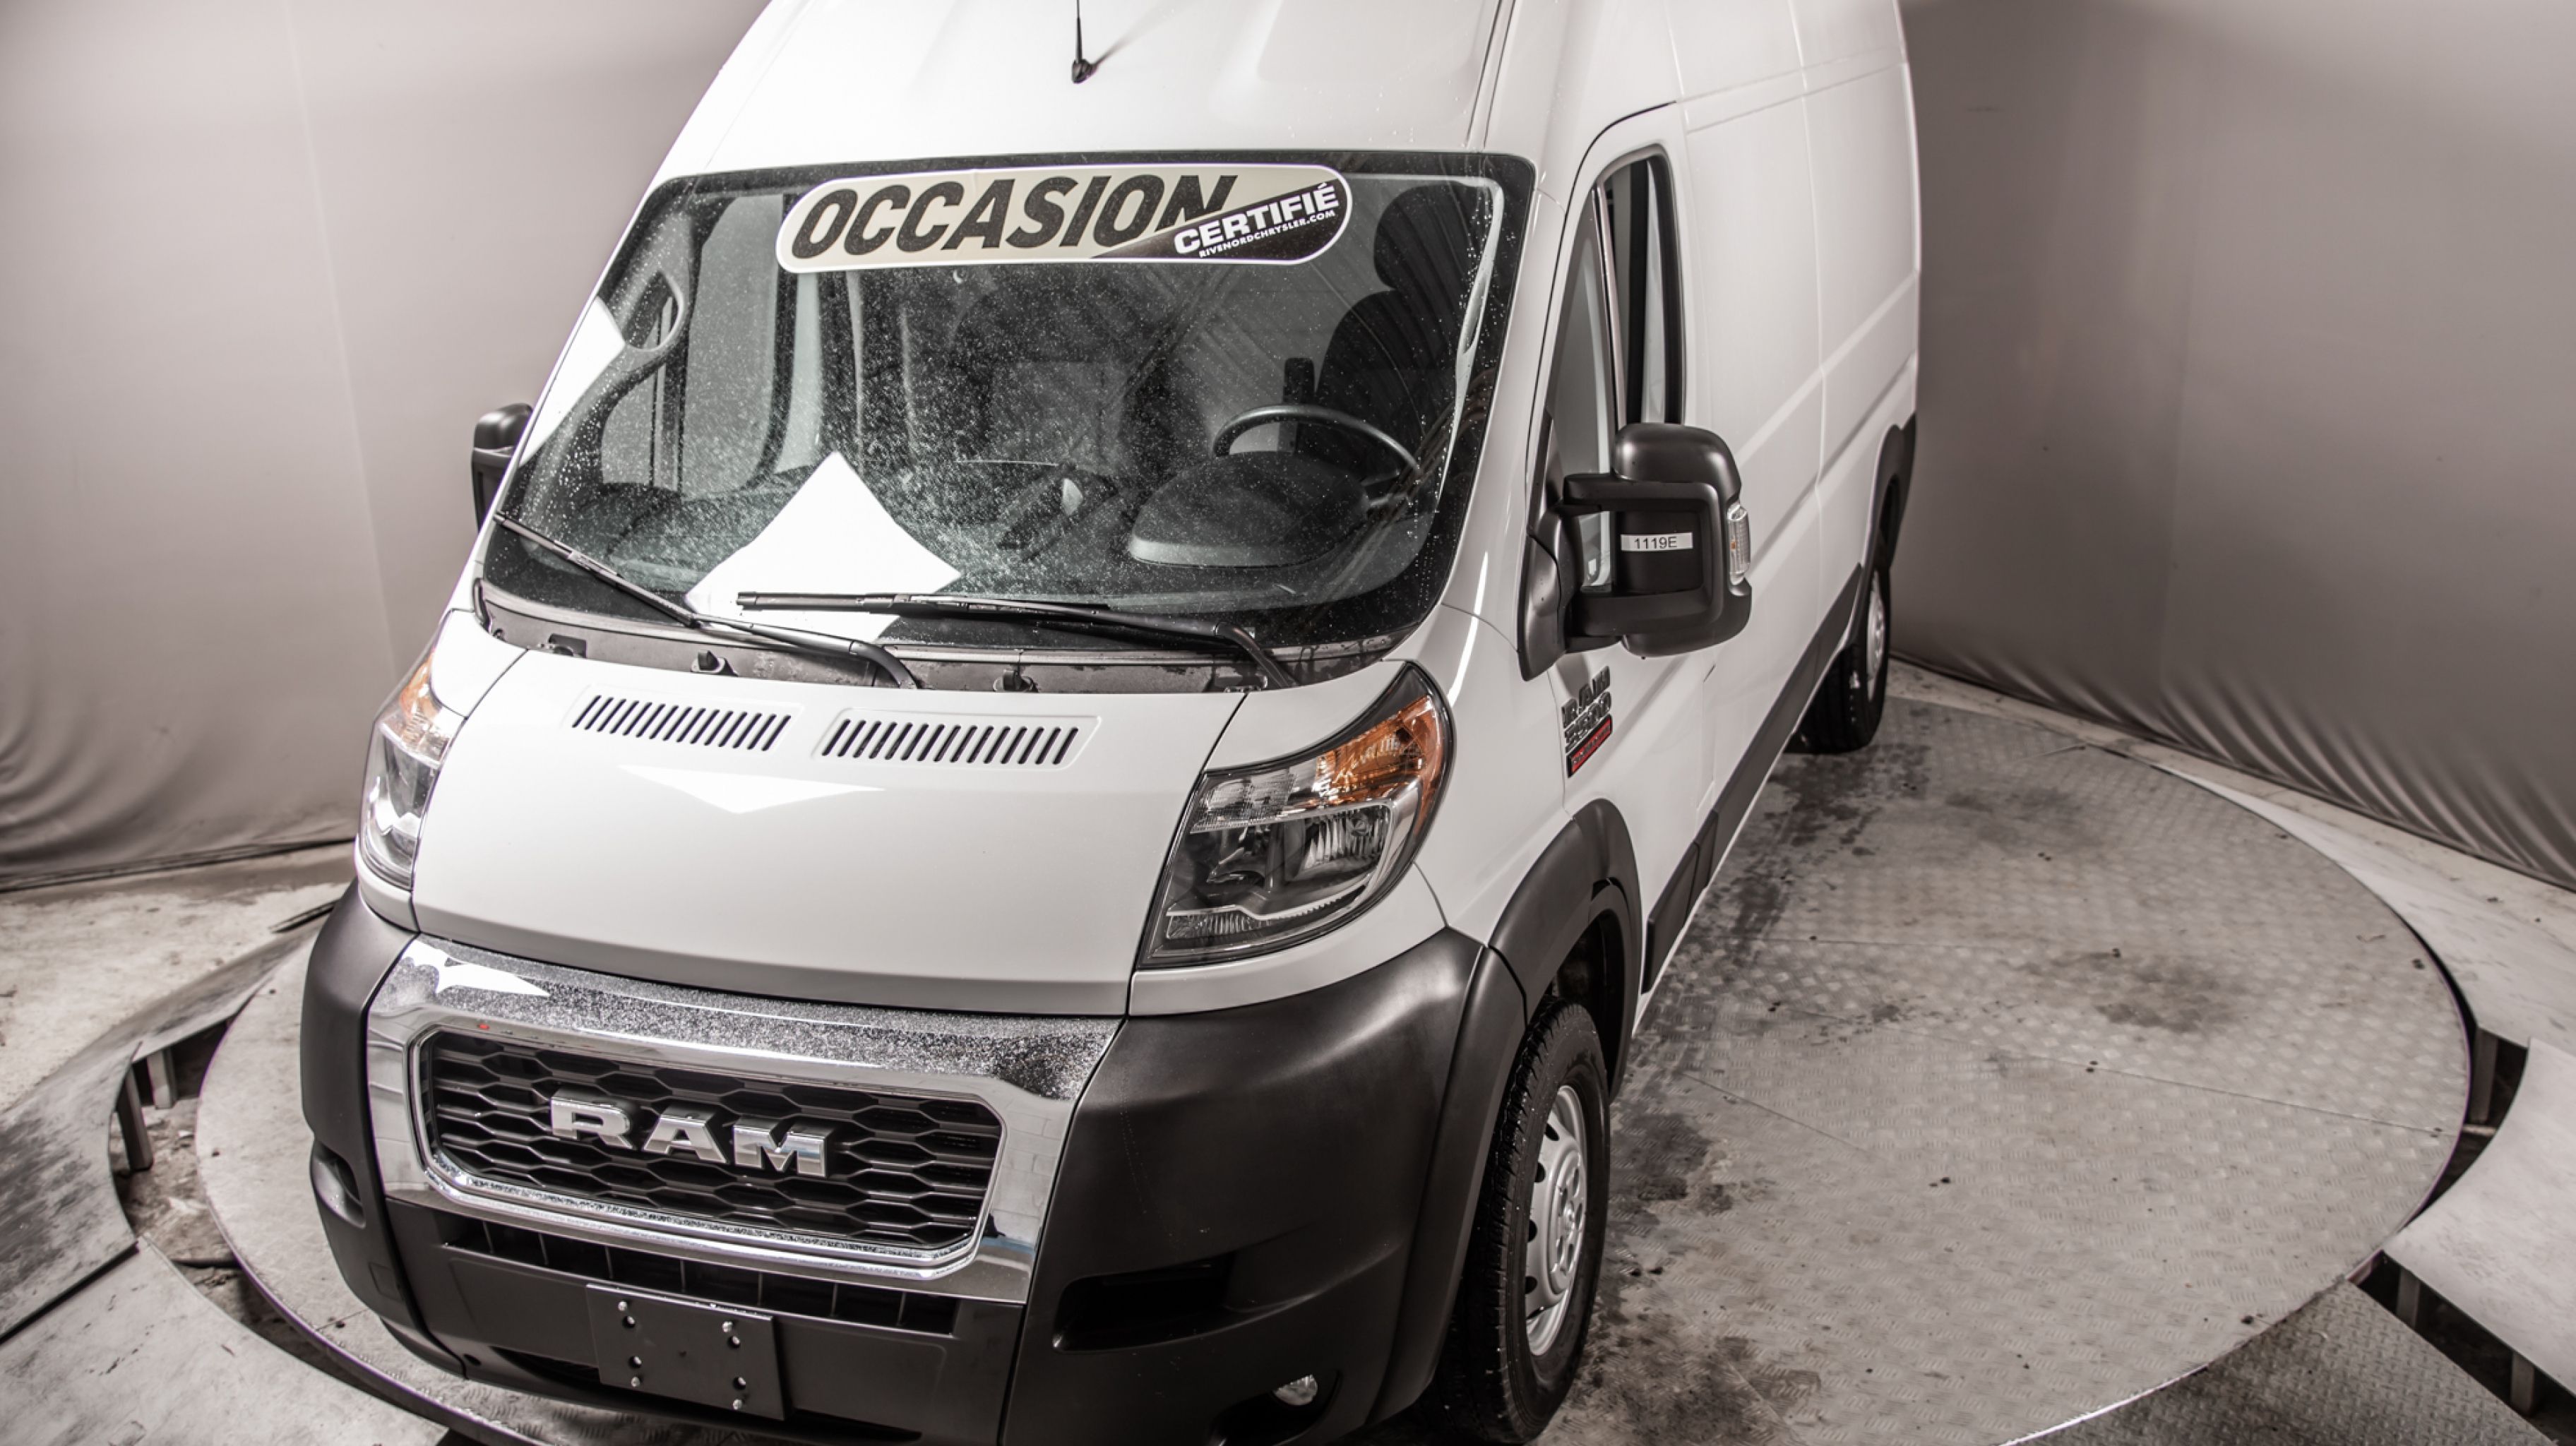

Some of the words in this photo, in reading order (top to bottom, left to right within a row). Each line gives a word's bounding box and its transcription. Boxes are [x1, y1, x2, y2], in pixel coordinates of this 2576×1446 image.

[792, 174, 1239, 260] OCCASION
[1174, 181, 1340, 254] CERTIFIÉ
[1199, 209, 1336, 258] RIVENORDCHRYSLER.COM
[1634, 536, 1678, 549] 1119E
[549, 1093, 829, 1178] RAM
